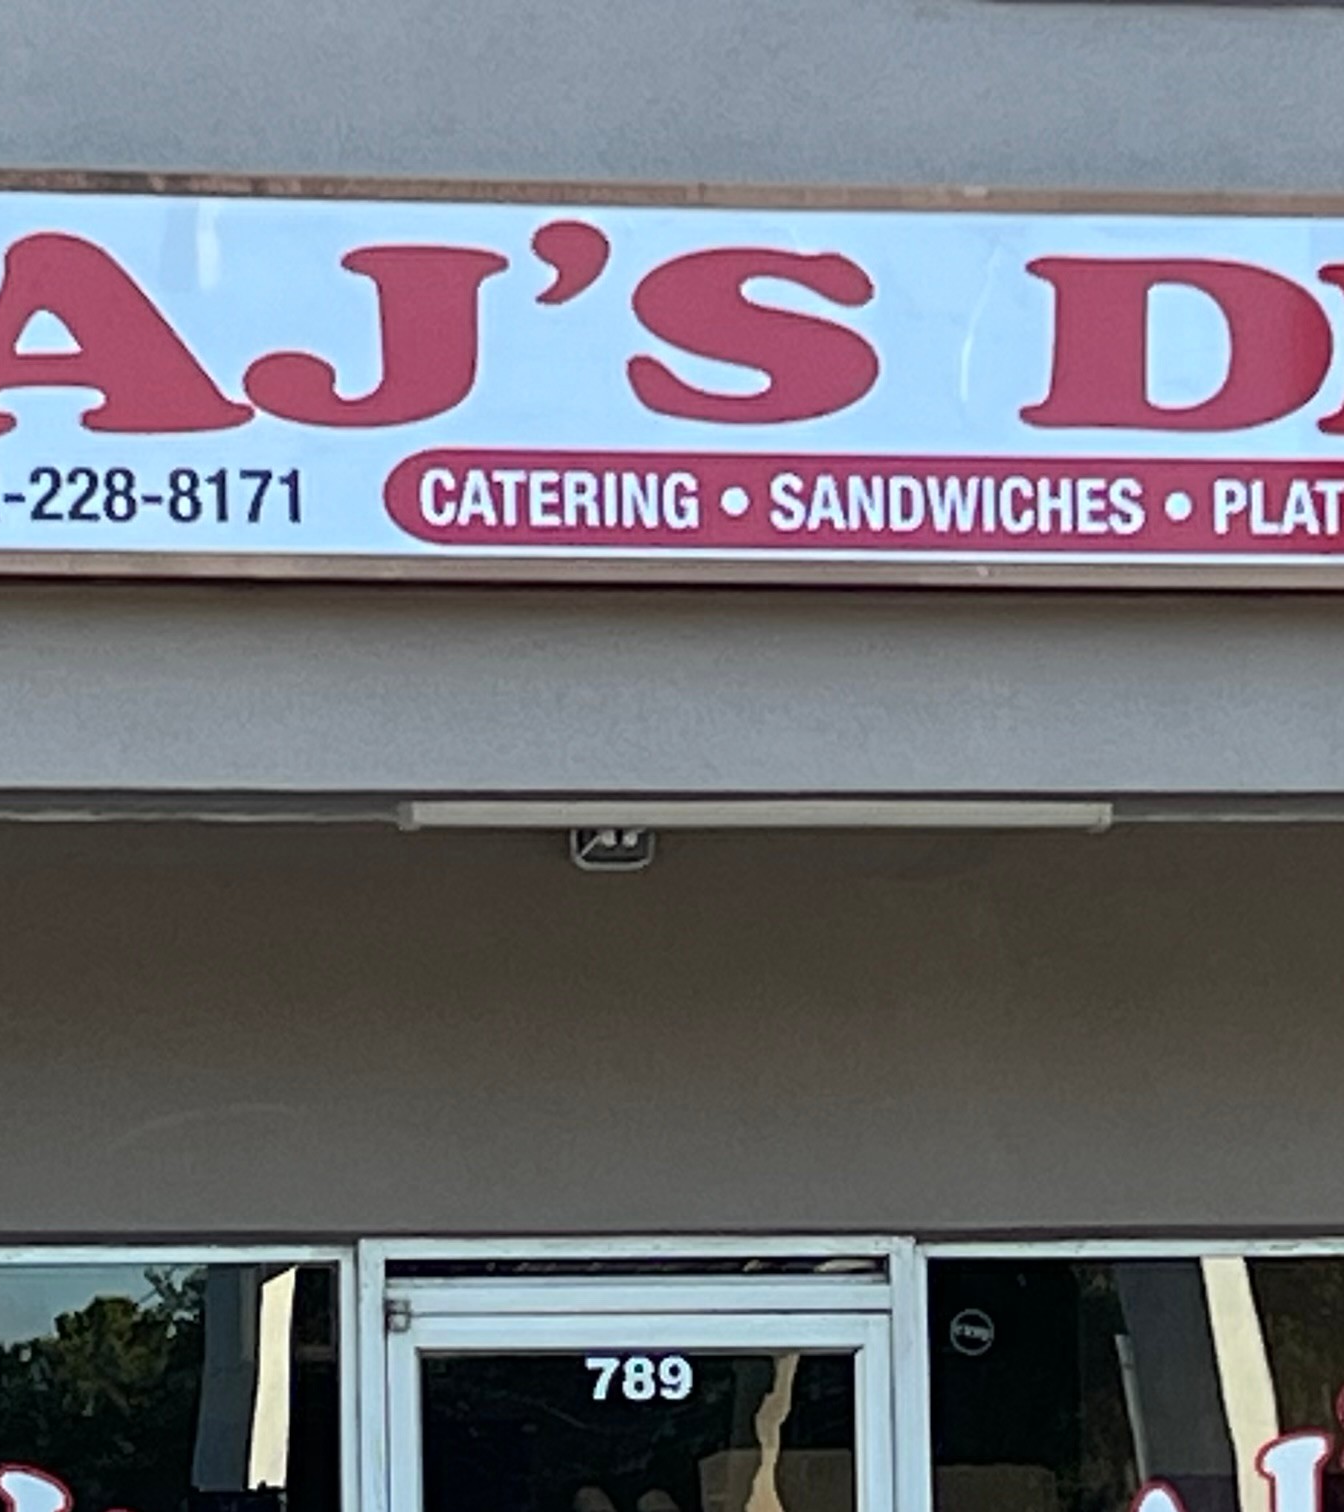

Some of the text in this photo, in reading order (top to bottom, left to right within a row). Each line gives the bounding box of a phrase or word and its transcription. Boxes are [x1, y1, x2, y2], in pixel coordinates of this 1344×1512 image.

[418, 469, 700, 531] CATERING
[769, 475, 1144, 536] SANDWICHES
[584, 1356, 694, 1401] 789
